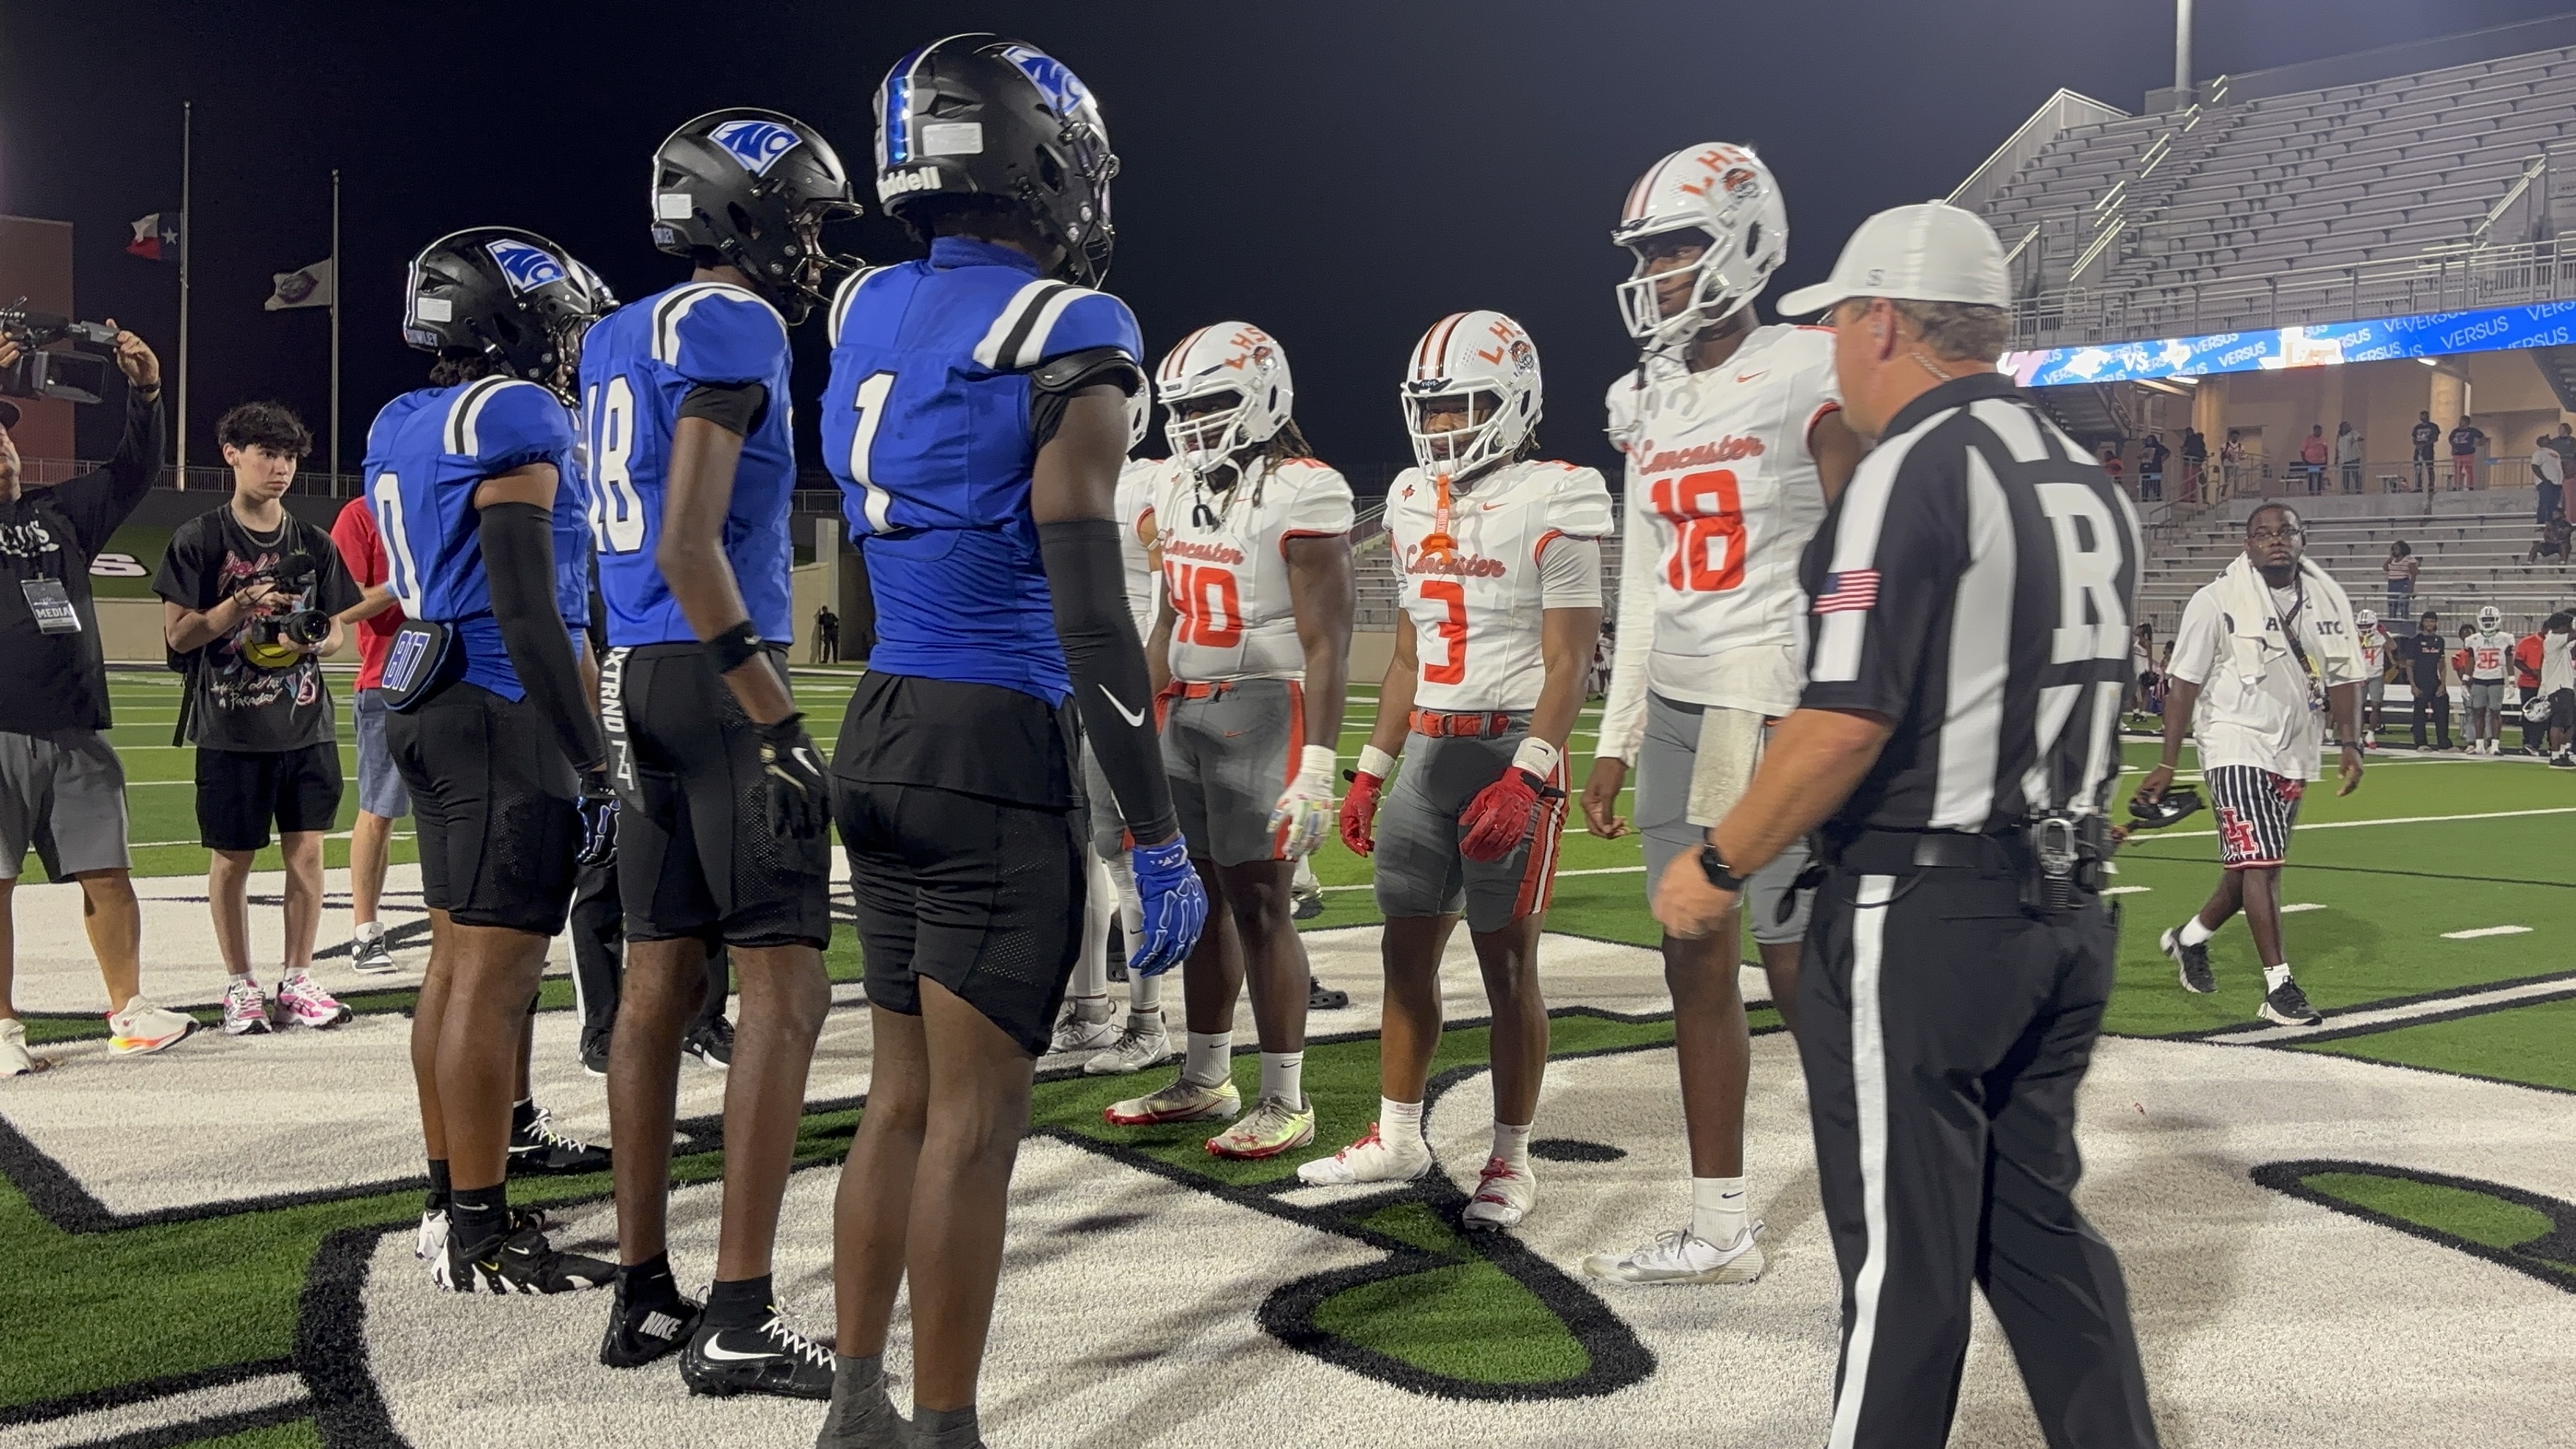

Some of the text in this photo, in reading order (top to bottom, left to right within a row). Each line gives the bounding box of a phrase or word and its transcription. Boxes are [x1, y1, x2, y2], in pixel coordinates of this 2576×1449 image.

[2122, 352, 2149, 372] VS
[2218, 340, 2266, 367] VERSUS
[2441, 316, 2509, 349] VERSUS
[588, 376, 645, 553] 18
[855, 373, 897, 534] 1
[1633, 435, 1766, 475] Lancaster
[374, 473, 422, 621] 0
[1651, 469, 1748, 591] 18
[2034, 483, 2130, 664] R
[35, 607, 72, 618] MEDIA
[1162, 561, 1243, 648] 40
[1420, 580, 1468, 686] 3
[638, 1311, 682, 1341] NIKE
